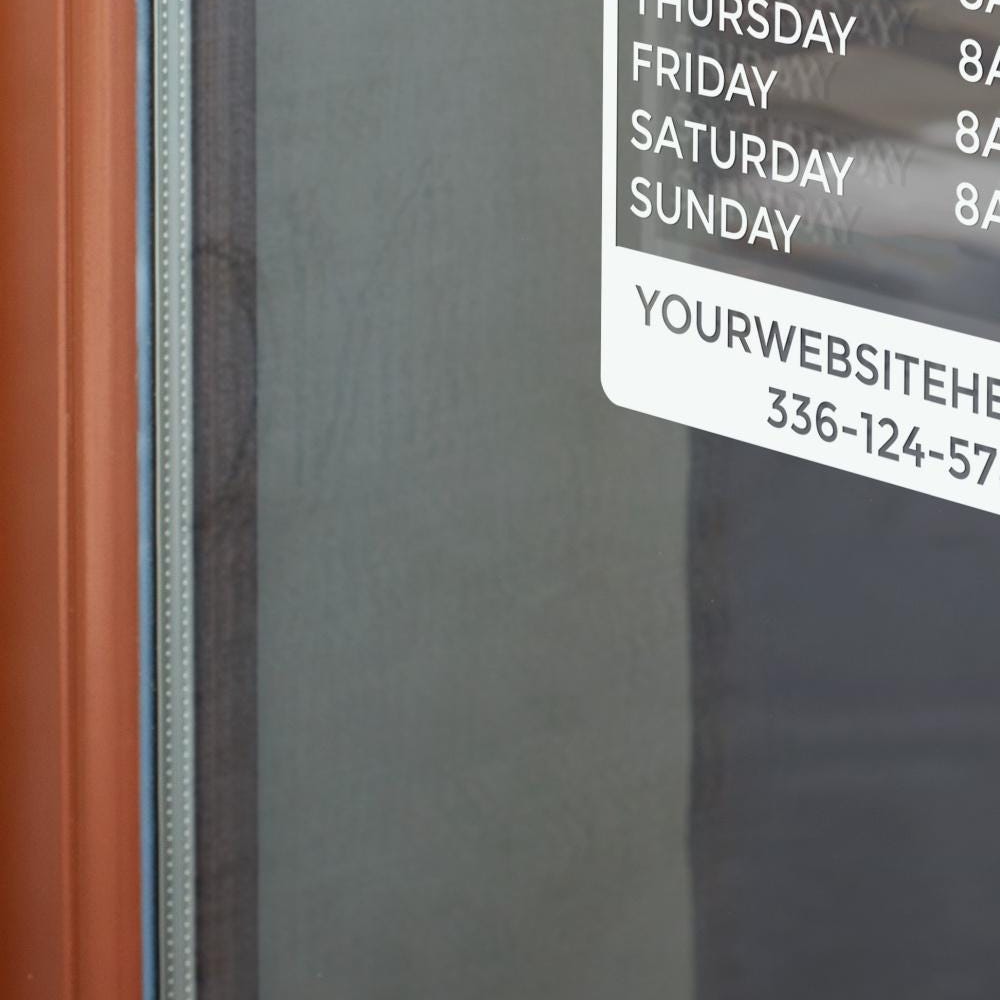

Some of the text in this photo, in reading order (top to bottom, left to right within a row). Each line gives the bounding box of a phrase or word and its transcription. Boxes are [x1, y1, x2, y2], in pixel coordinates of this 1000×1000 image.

[632, 41, 778, 109] FRIDAY
[630, 109, 854, 196] SATURDAY
[630, 176, 801, 253] SUNDAY
